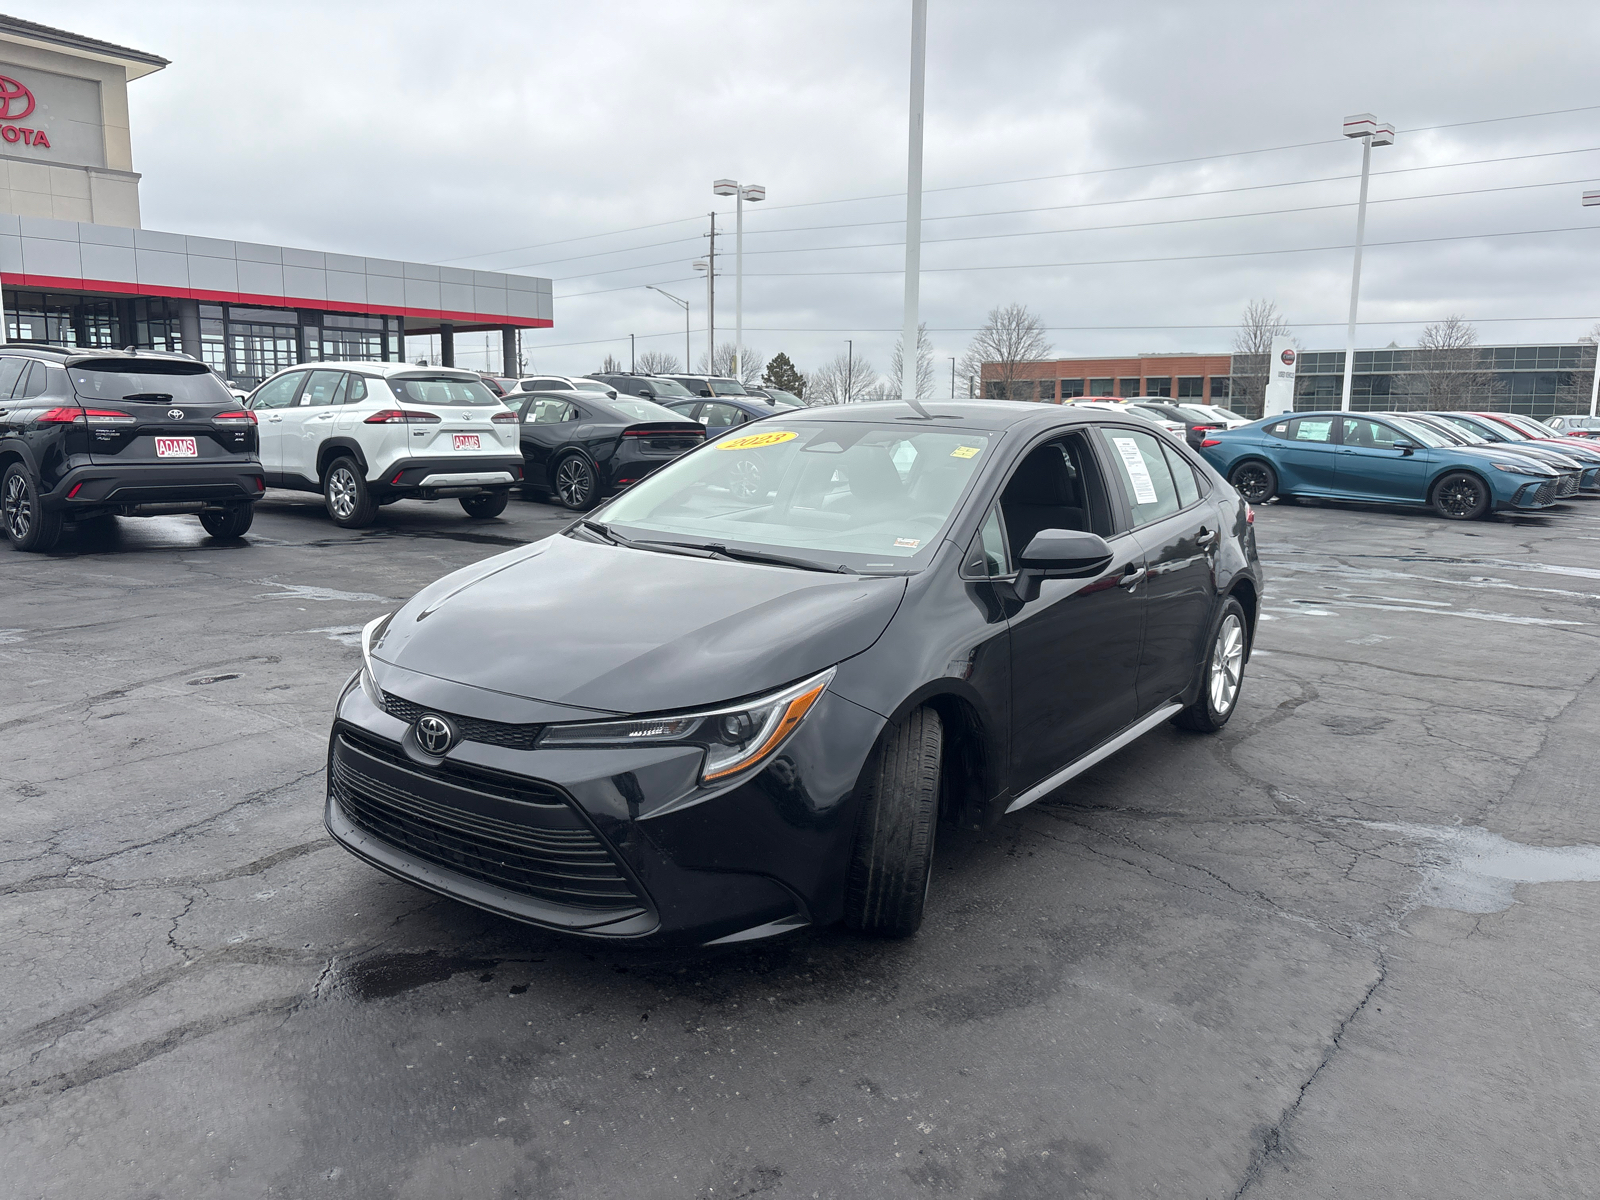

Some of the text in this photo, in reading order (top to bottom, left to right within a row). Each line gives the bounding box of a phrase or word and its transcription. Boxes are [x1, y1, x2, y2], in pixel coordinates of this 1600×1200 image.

[0, 124, 51, 148] OTA
[159, 440, 194, 454] ADAMS
[456, 436, 479, 448] ADAMS
[724, 433, 787, 448] 2023
